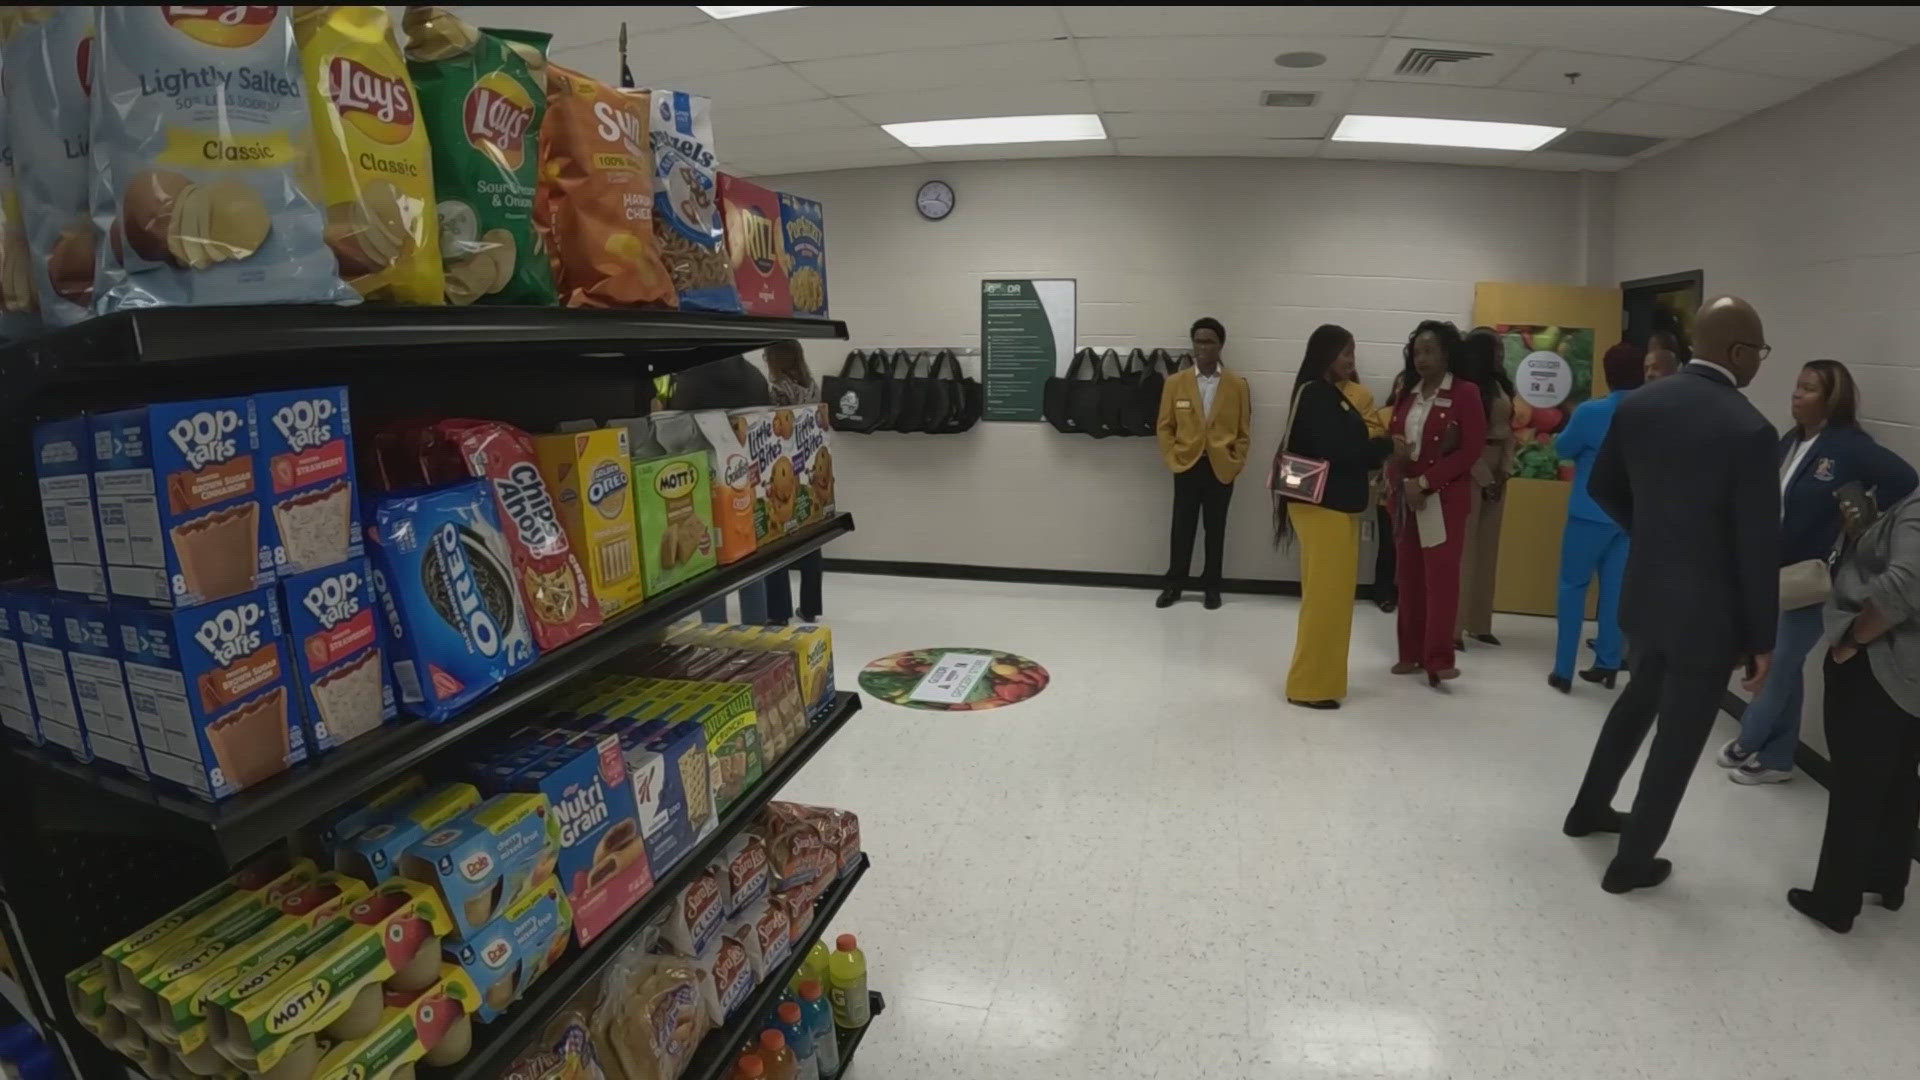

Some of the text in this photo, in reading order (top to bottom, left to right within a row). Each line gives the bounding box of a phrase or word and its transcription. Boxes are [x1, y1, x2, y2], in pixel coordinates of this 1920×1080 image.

[139, 66, 301, 98] Lightly Salted
[202, 140, 275, 162] Classic
[359, 153, 418, 177] Classic
[748, 420, 772, 460] Little
[759, 439, 782, 473] Bites
[588, 472, 629, 504] OREO
[660, 468, 695, 491] MOTT'S
[273, 545, 287, 565] 8
[172, 574, 186, 594] 8
[442, 522, 499, 656] OREO
[315, 721, 328, 739] 8
[210, 767, 224, 787] 8
[552, 775, 604, 824] Nutri
[560, 802, 609, 848] Grain
[467, 856, 490, 877] Dole
[487, 943, 508, 964] Dole
[273, 983, 327, 1030] MOTT'S
